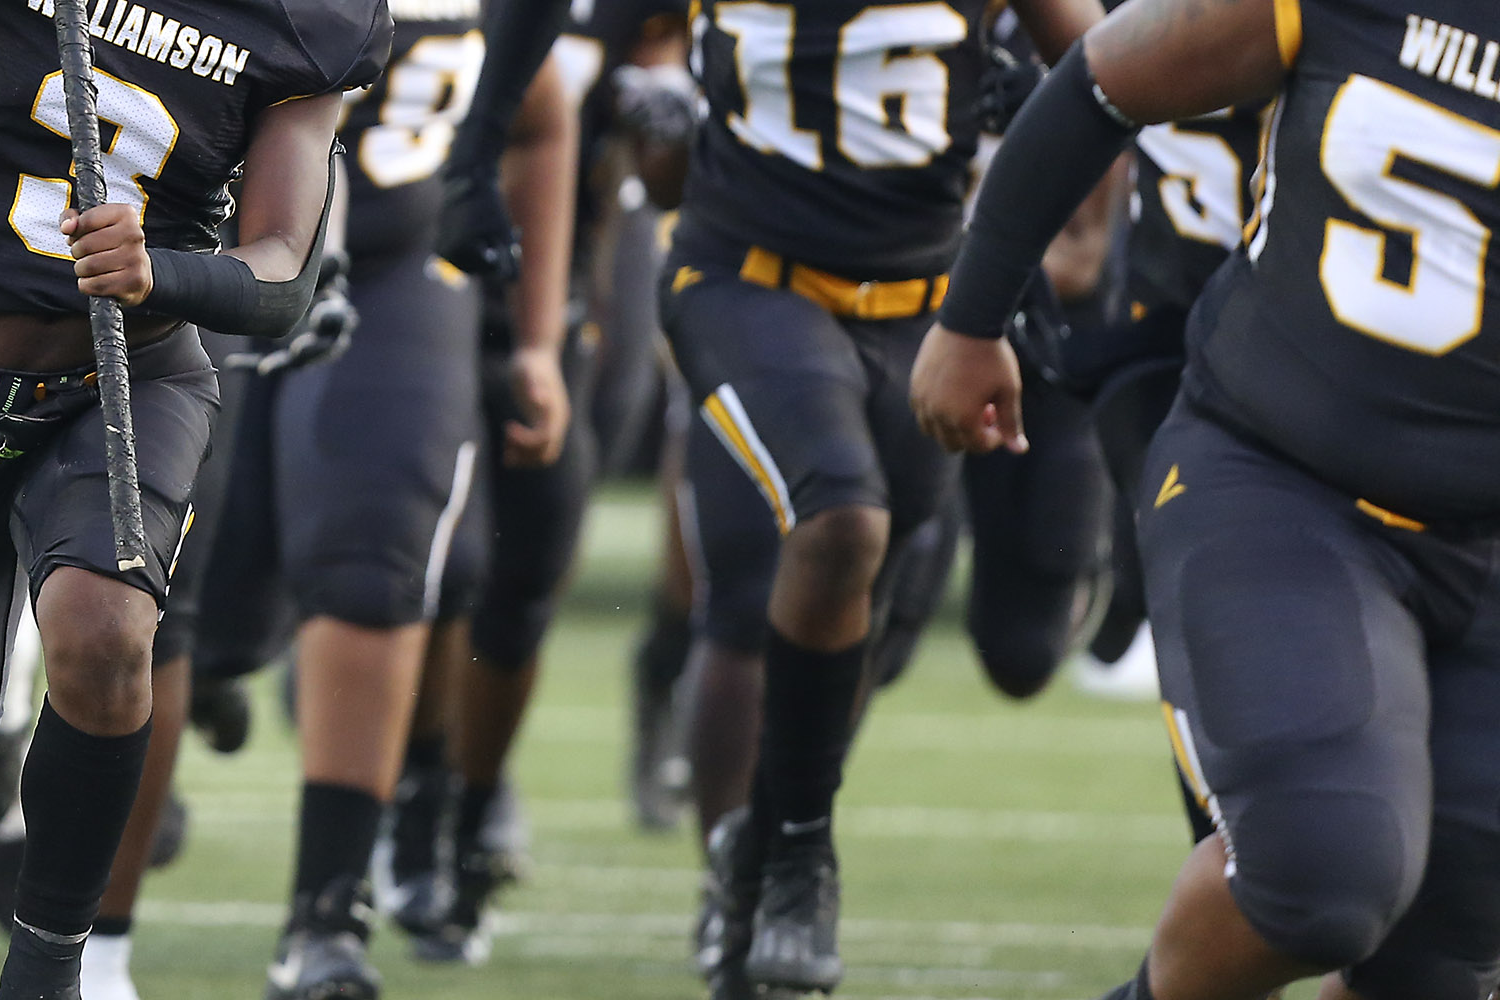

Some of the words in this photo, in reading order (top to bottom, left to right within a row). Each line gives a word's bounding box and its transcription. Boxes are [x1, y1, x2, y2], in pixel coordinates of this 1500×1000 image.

[713, 0, 968, 172] 16
[1399, 14, 1500, 99] WILL
[8, 65, 180, 262] 3
